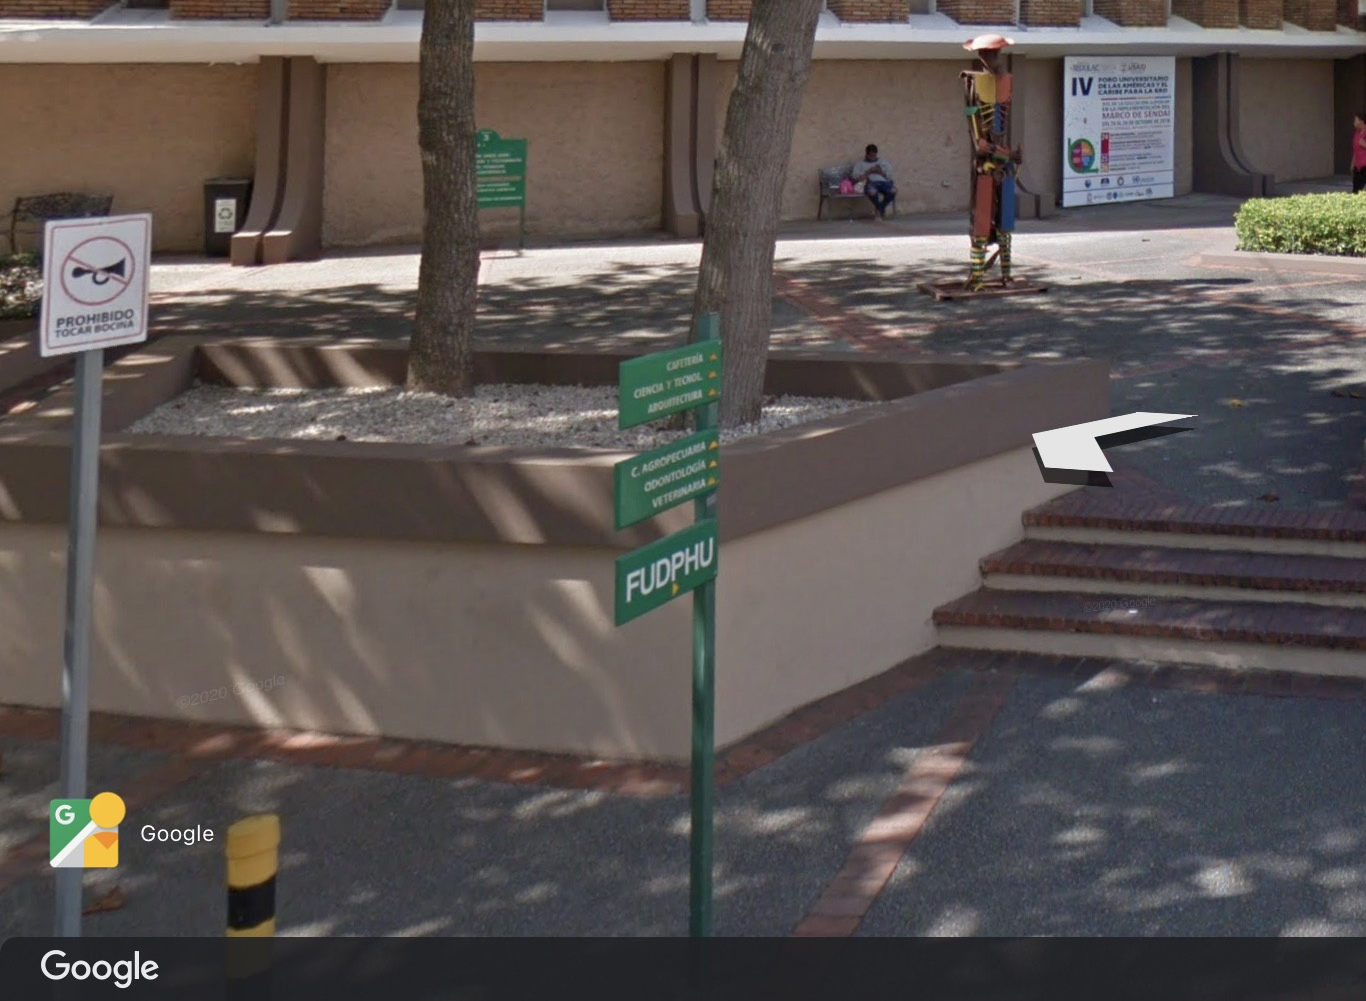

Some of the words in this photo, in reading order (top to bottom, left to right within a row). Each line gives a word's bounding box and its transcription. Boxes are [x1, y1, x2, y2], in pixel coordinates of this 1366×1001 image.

[1071, 76, 1094, 97] IV
[1118, 75, 1169, 83] UNIVERSITARIO
[1102, 111, 1131, 119] MARCO
[1144, 109, 1171, 117] SENDAI
[54, 325, 93, 338] TOCAR
[94, 319, 135, 334] BOCINA
[56, 308, 135, 329] PROHIBIDO
[666, 351, 704, 371] CAFETERÍA
[633, 382, 664, 399] CIENCIA
[666, 380, 672, 390] Y
[674, 372, 703, 387] TECNOL.
[647, 389, 703, 414] ARQUITECTURA
[631, 466, 640, 478] C.
[642, 441, 706, 474] AGROPECUARIA
[644, 459, 707, 492] ODONTOLOGÍA
[652, 478, 706, 508] VETERINARIA
[625, 537, 714, 603] FUDPHU
